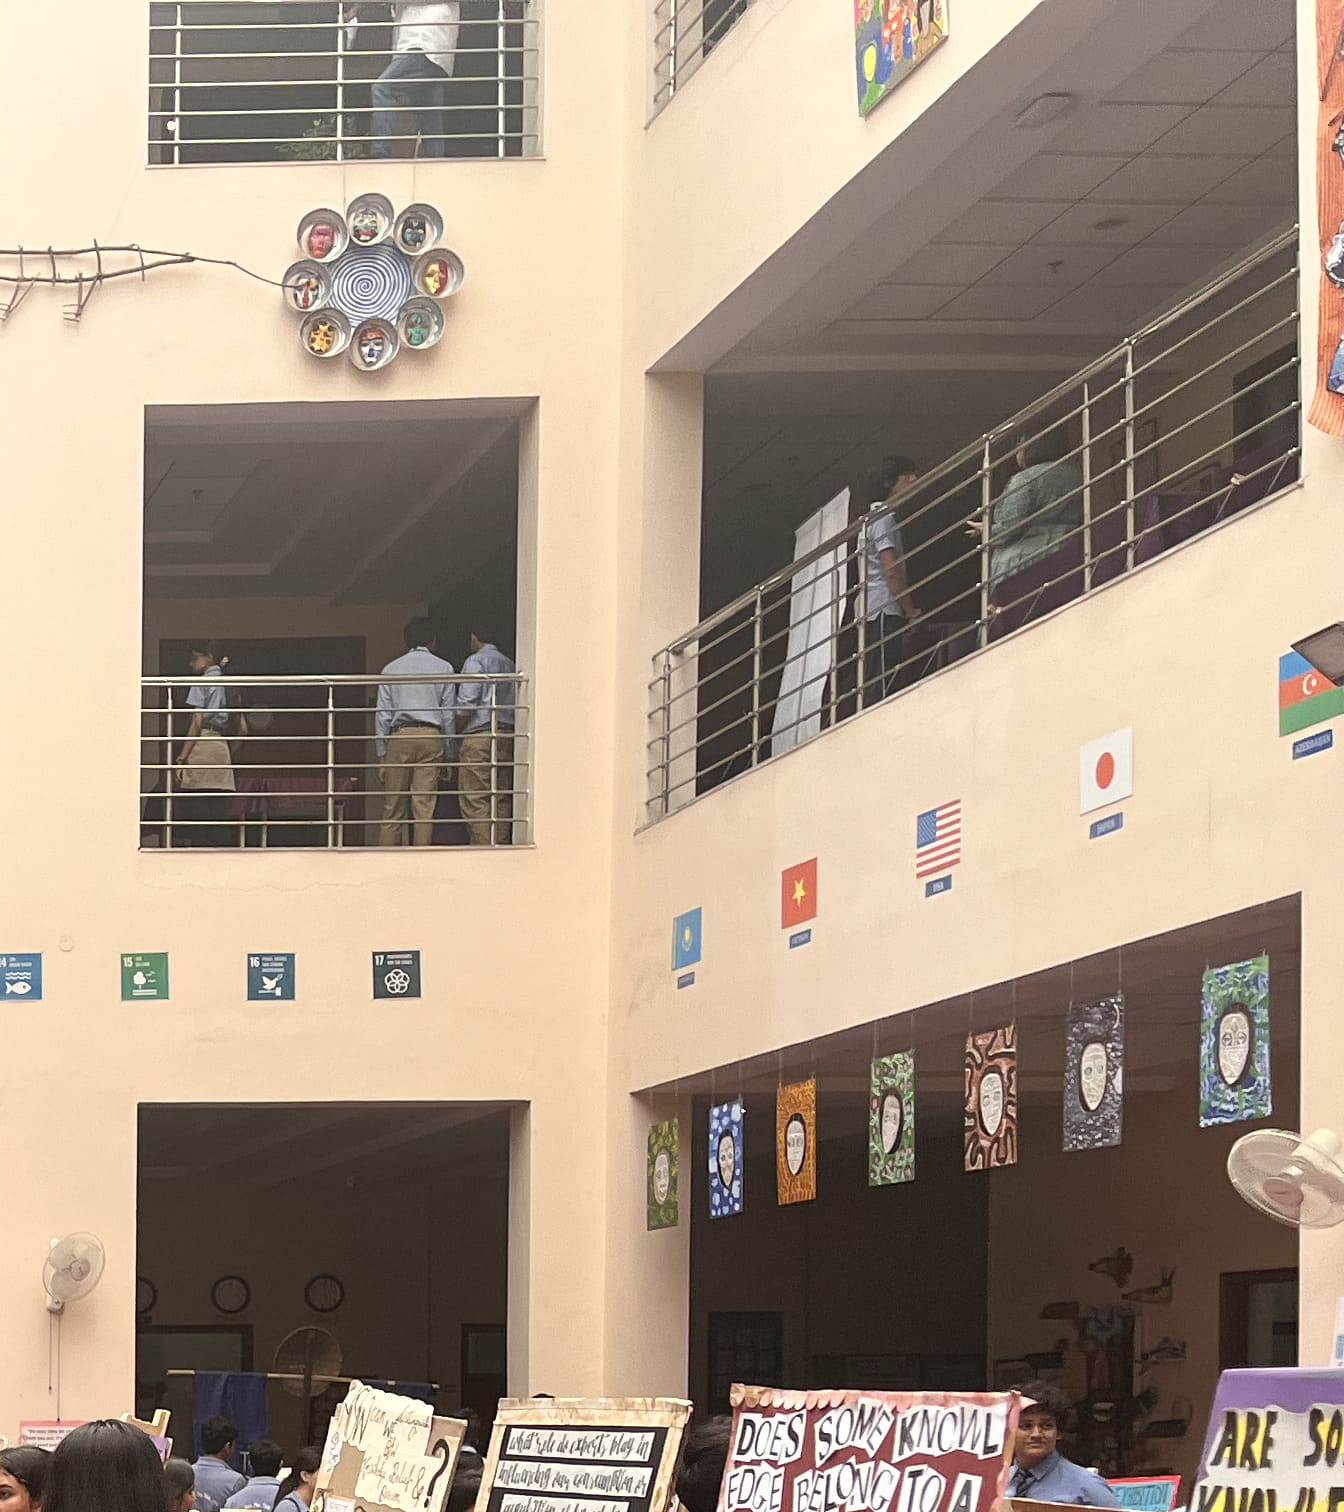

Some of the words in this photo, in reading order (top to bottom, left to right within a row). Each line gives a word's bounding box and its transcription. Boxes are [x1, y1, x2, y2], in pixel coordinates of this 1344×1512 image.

[736, 1413, 803, 1458] DOES
[816, 1404, 892, 1461] SOME
[1210, 1411, 1277, 1470] ARE
[1303, 1408, 1344, 1468] SO
[728, 1468, 781, 1511] EDGE
